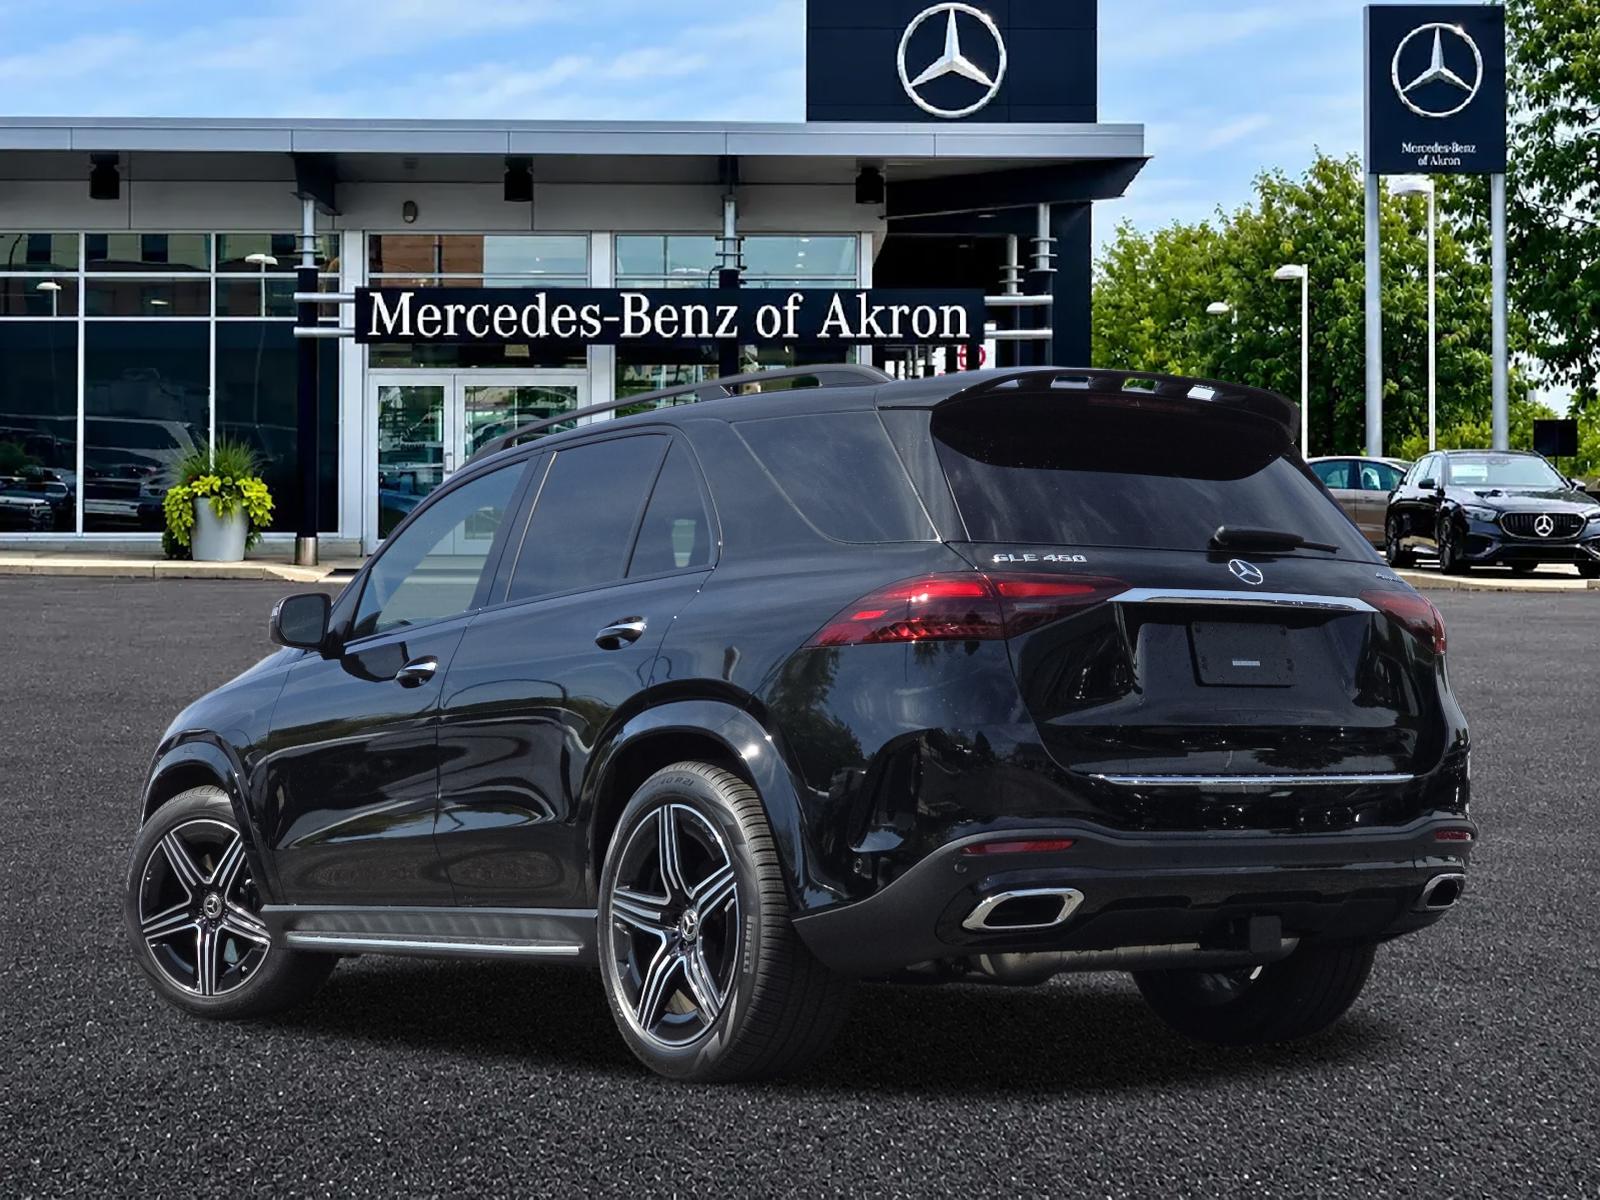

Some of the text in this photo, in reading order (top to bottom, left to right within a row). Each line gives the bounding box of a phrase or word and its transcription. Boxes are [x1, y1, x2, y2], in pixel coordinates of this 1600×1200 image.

[1401, 142, 1476, 153] Mercedes-Benz
[1418, 155, 1461, 165] of Akron
[367, 291, 970, 338] Mercedes-Benz of Akron
[992, 553, 1088, 563] GLE 450
